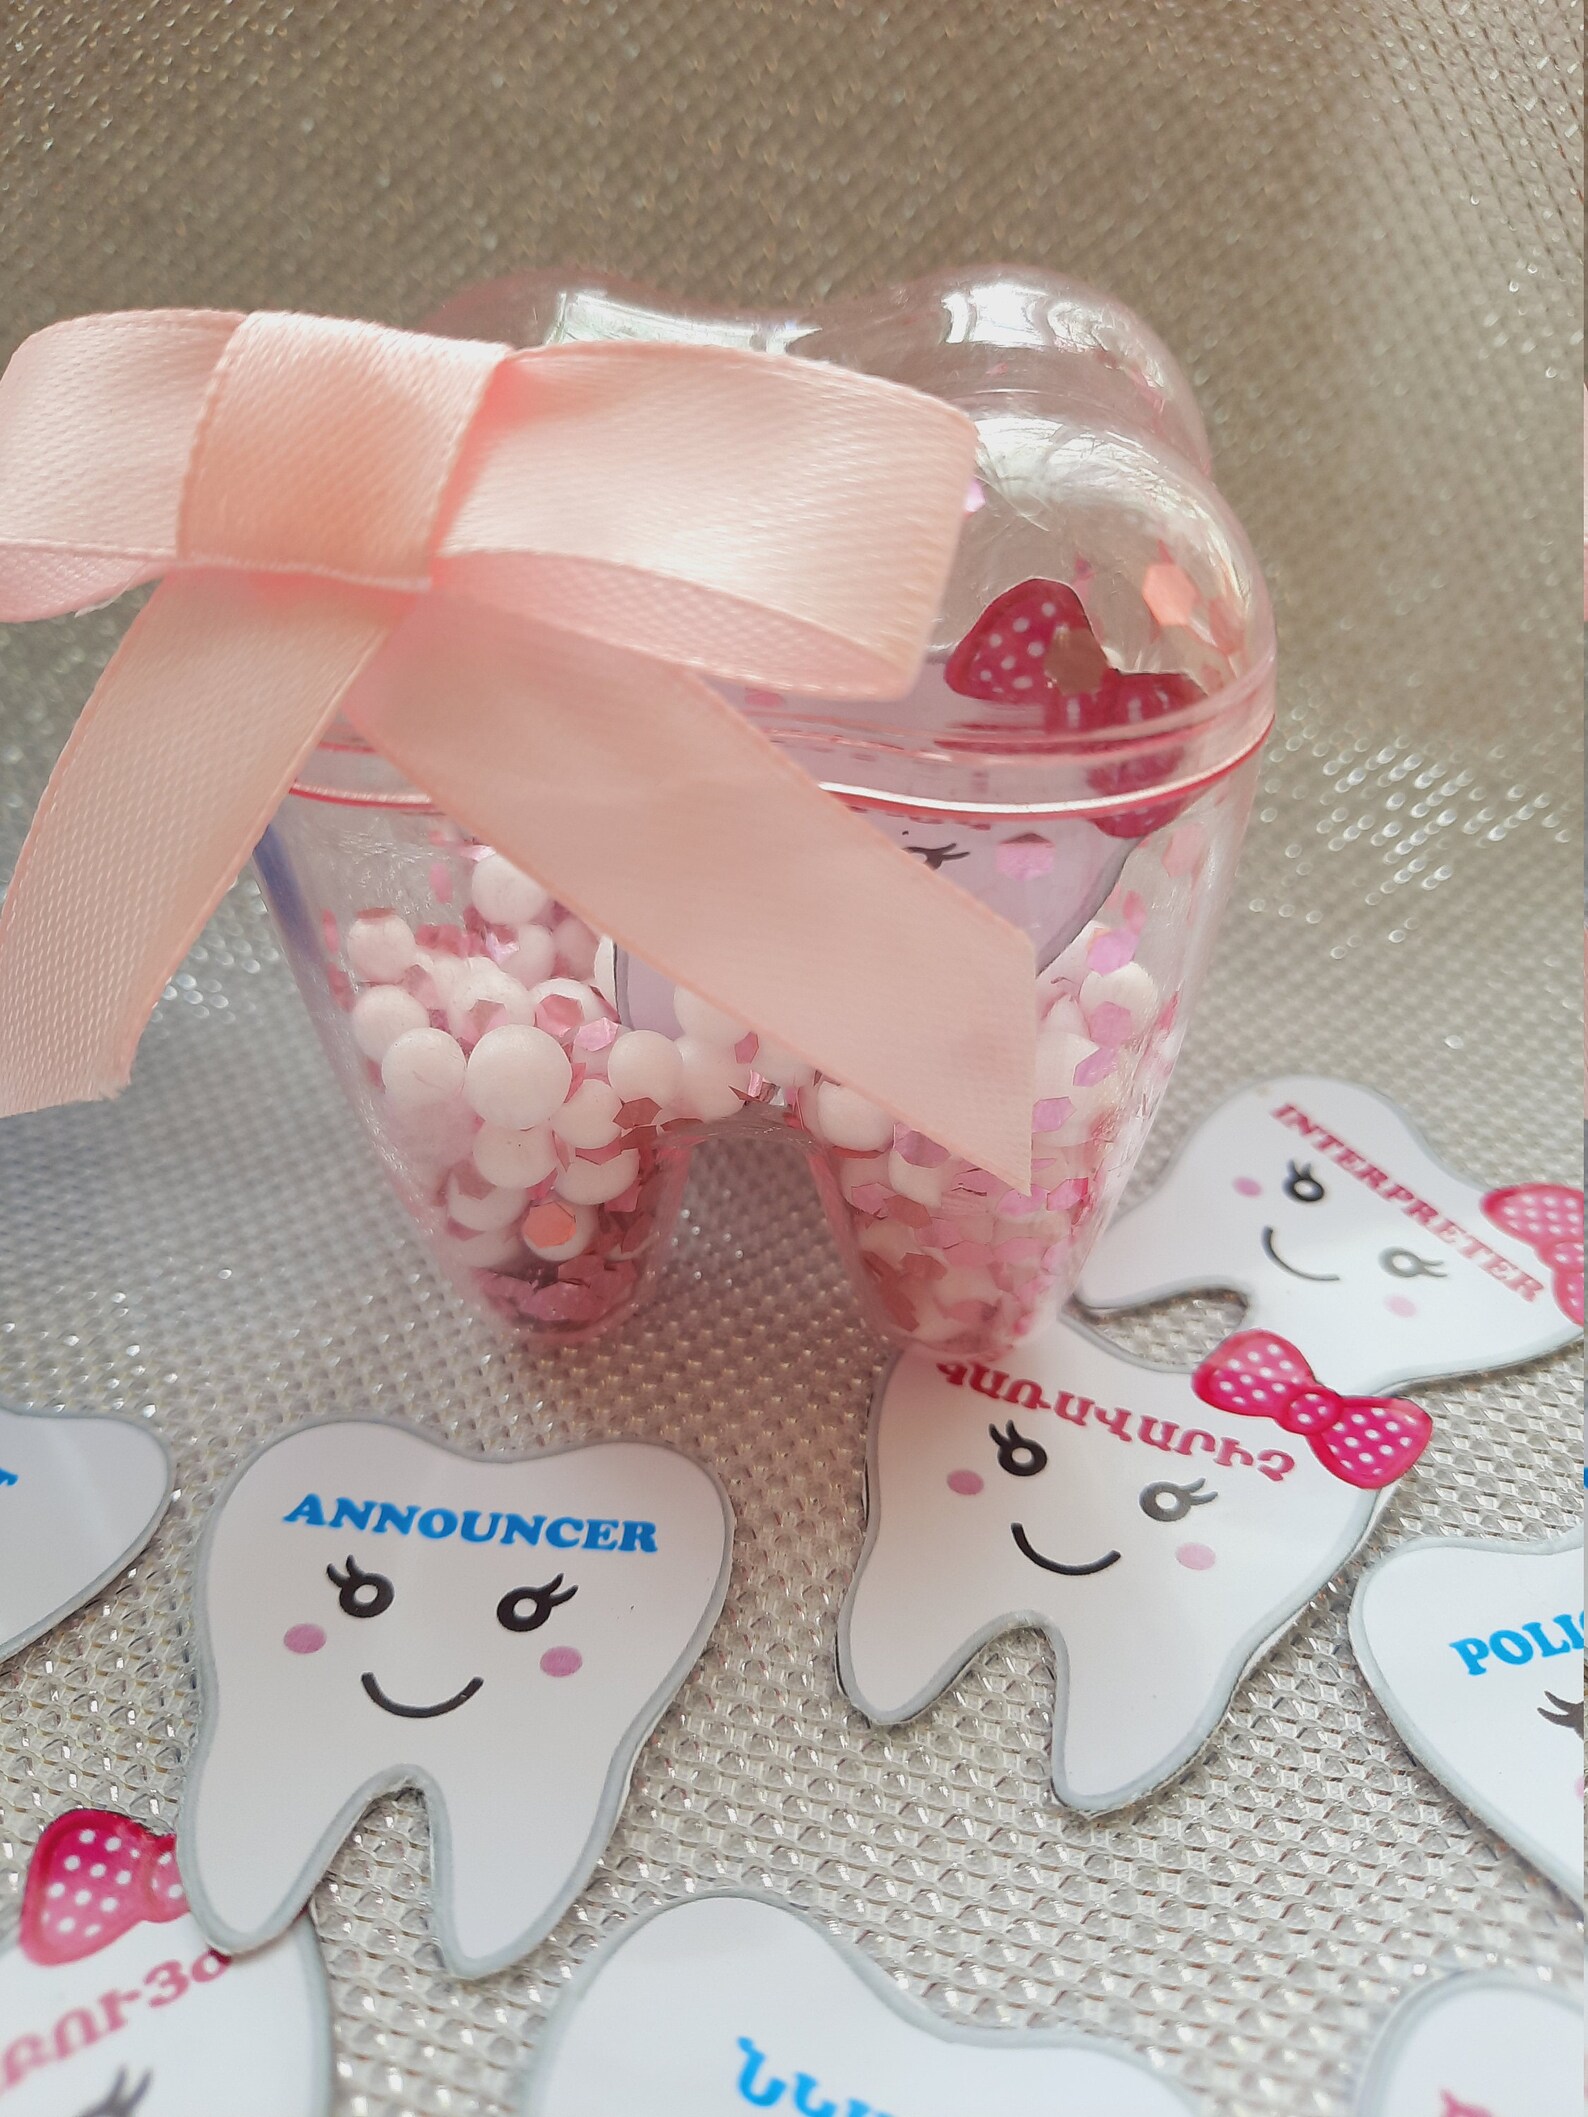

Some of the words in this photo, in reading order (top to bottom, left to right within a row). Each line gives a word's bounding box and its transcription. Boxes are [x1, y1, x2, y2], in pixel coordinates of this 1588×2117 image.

[1271, 1103, 1545, 1302] INTERPRETER
[282, 1493, 658, 1553] ANNOUNCER
[1448, 1610, 1585, 1676] POLI
